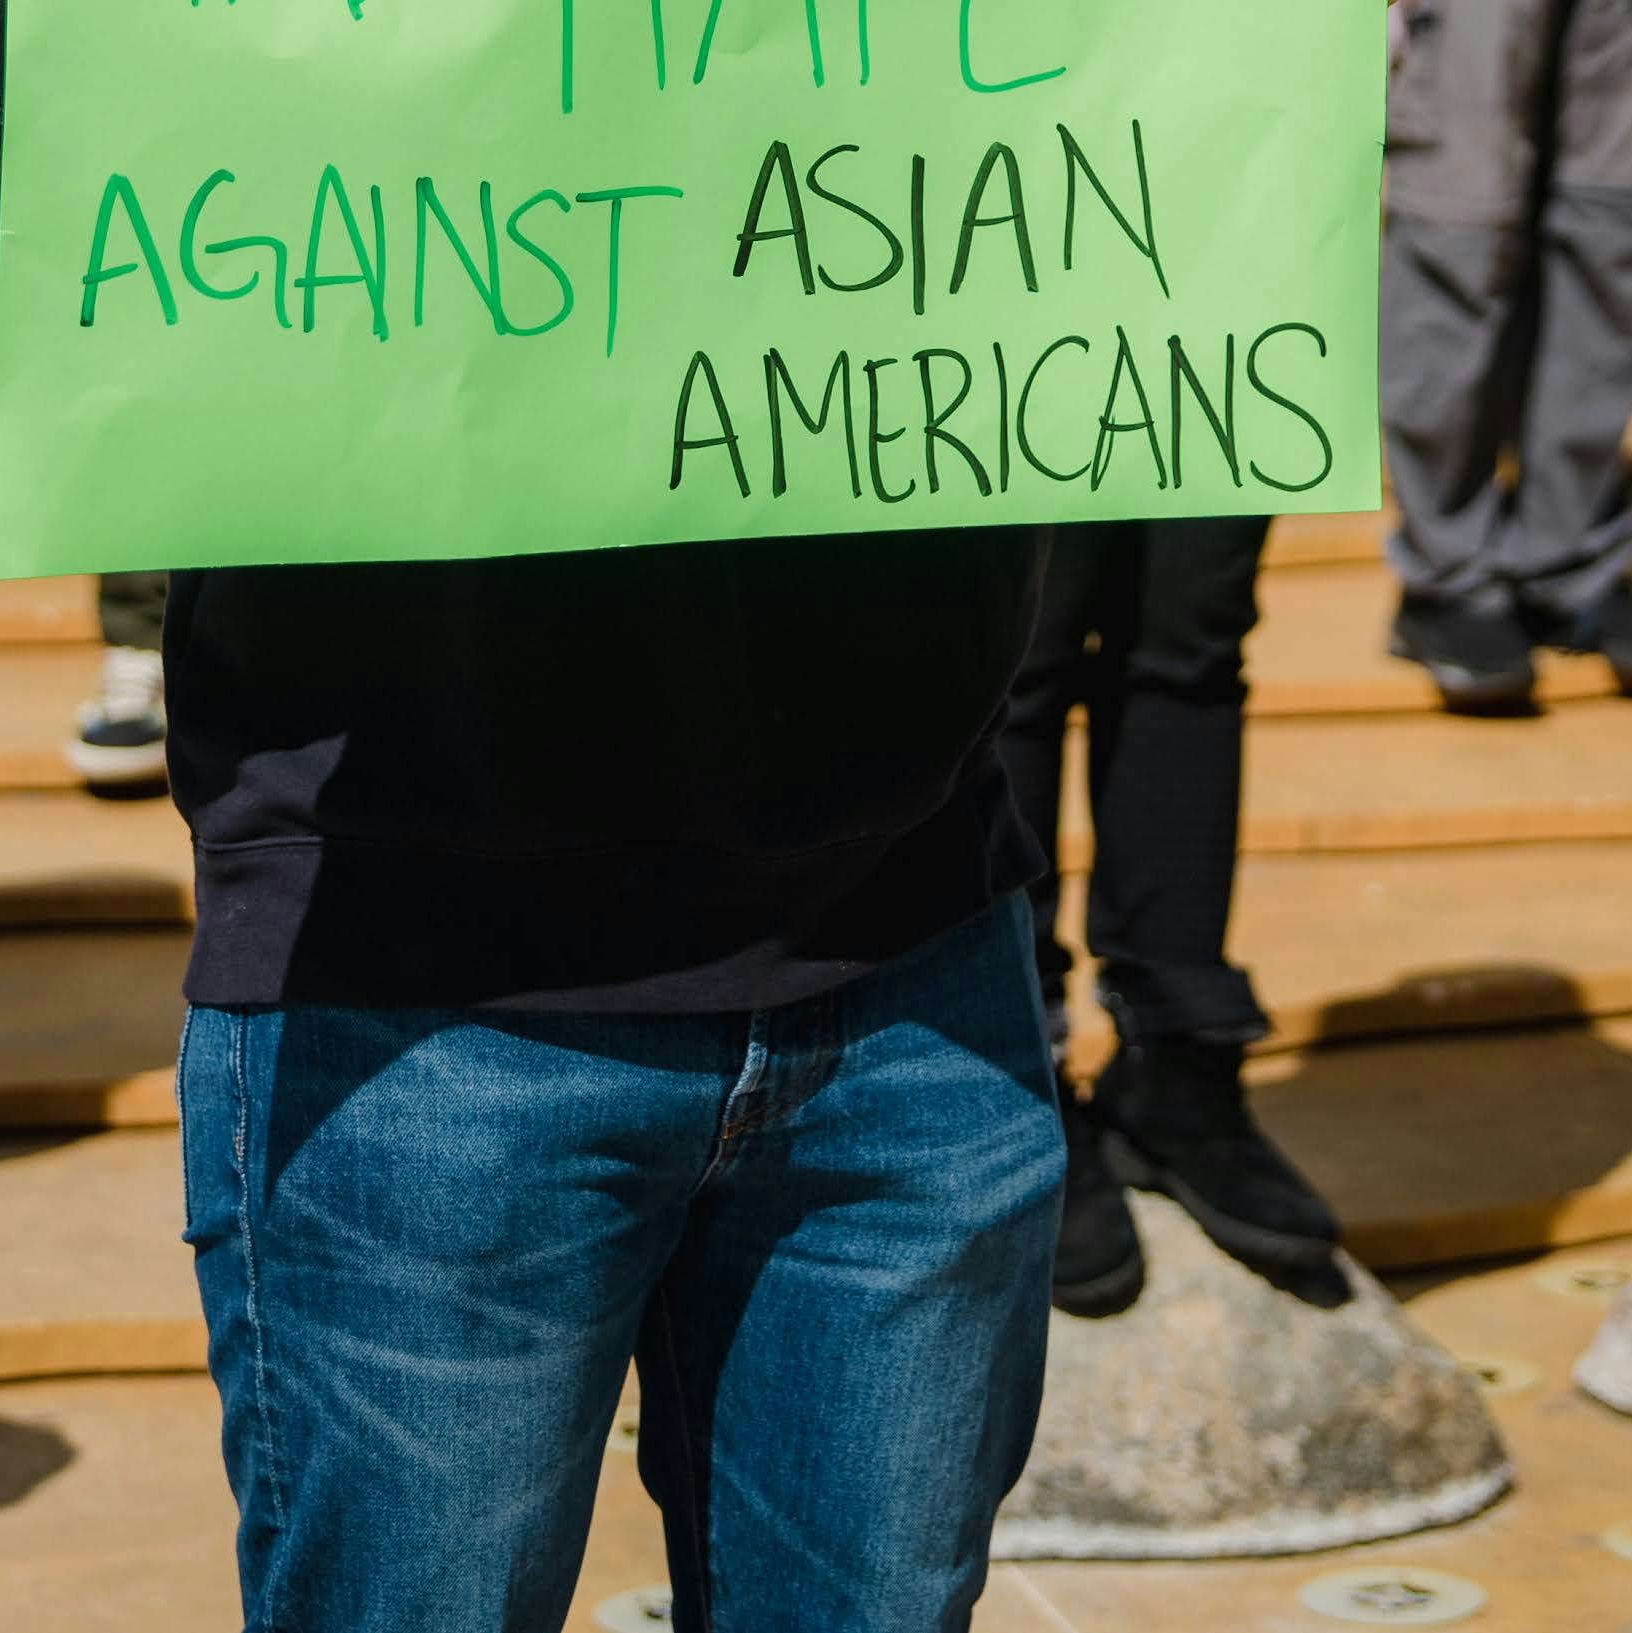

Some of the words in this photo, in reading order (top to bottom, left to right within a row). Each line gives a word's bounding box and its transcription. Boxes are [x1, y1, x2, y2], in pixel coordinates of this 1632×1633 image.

[80, 164, 683, 358] AGAINST
[733, 120, 1169, 315] ASIAN
[669, 323, 1332, 503] AMERICANS
